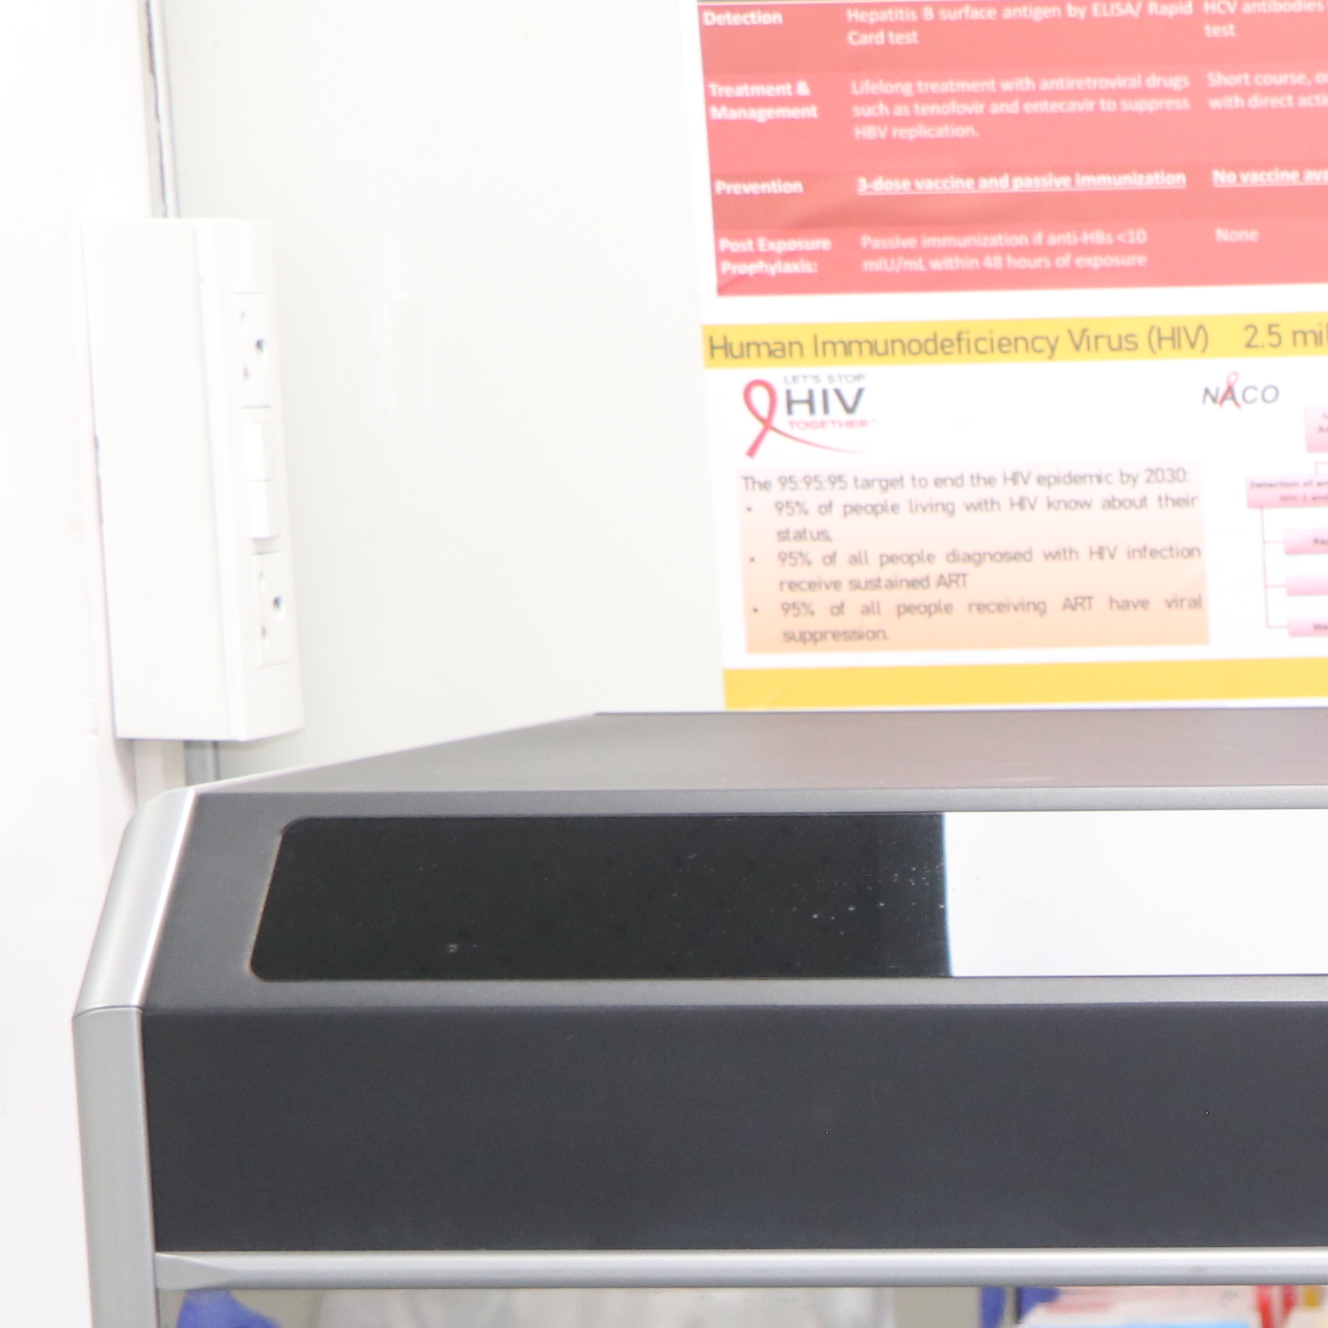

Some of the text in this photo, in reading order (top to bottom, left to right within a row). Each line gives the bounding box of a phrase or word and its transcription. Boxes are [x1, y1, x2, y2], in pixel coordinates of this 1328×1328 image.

[700, 10, 783, 25] Detection
[845, 0, 1194, 24] Hepatitis B surface antigen by ELISA/ Rapid
[845, 29, 919, 45] Card test
[1203, 23, 1235, 37] test
[849, 74, 1190, 96] Lifelong treatment with antiretroviral drugs
[1206, 71, 1250, 87] Short
[1253, 72, 1312, 86] course,
[707, 80, 811, 97] Treatment &
[1207, 93, 1244, 109] with
[1247, 93, 1293, 108] direct
[708, 104, 818, 122] Management
[855, 171, 1187, 193] 3-dose vaccine and passive immunization
[1210, 169, 1237, 186] No
[1239, 168, 1300, 186] vaccine
[713, 179, 804, 194] Prevention
[1214, 228, 1259, 242] None
[717, 236, 832, 254] Post Exposure
[718, 259, 818, 275] Prophylaxis:
[707, 324, 1214, 361] Human Immunodeficiency Virus (HIV)
[1242, 324, 1282, 351] 2.5
[784, 387, 864, 415] HIV
[1202, 381, 1279, 407] NACO
[788, 419, 868, 429] TOGETHER
[740, 475, 771, 492] The
[853, 475, 904, 494] target
[910, 474, 928, 489] to
[933, 473, 964, 489] end
[969, 472, 996, 488] the
[1002, 470, 1030, 487] HIV
[1035, 471, 1110, 488] epidemic
[1118, 468, 1137, 487] by
[773, 493, 1196, 518] 95% of people living with HIV know about their
